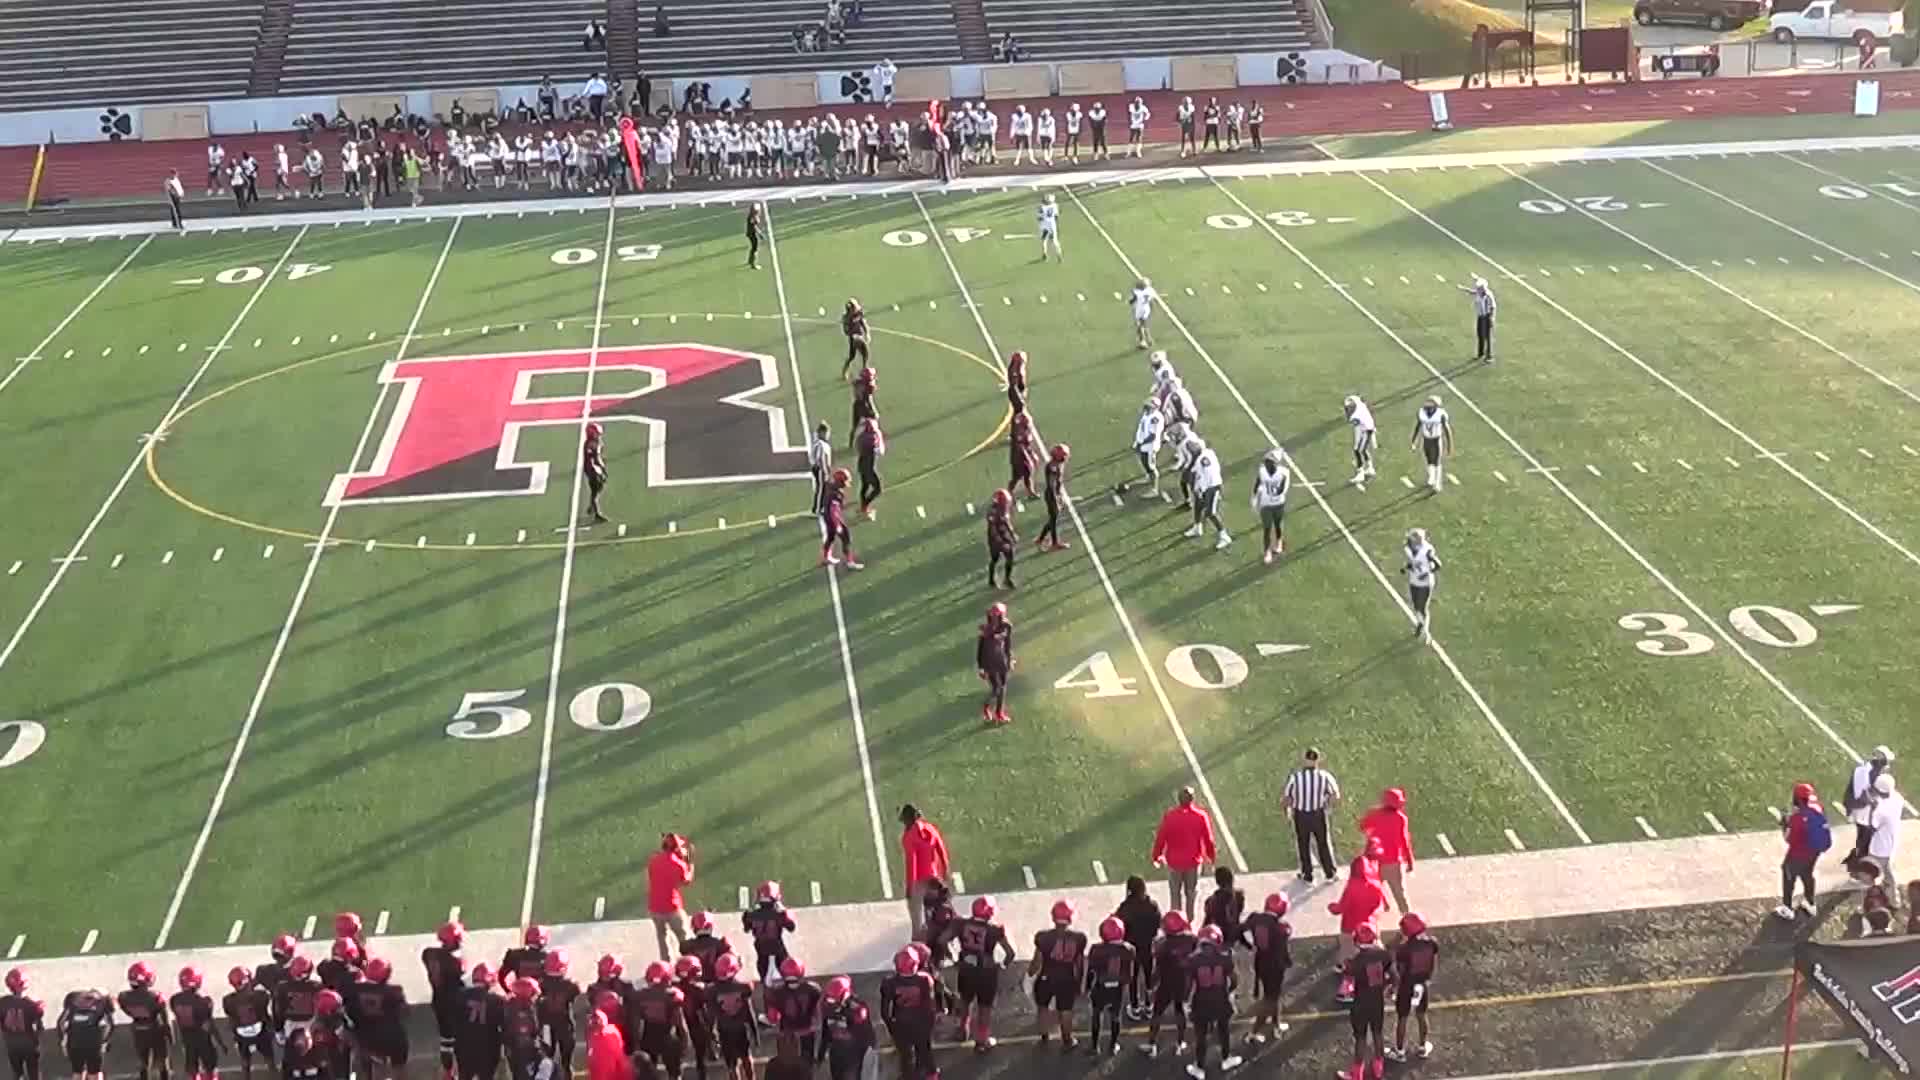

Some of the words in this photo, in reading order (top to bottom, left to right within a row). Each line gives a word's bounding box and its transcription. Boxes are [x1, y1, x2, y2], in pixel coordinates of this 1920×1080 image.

[1519, 196, 1628, 213] 20
[1206, 211, 1316, 229] 30
[882, 228, 992, 246] 40
[551, 244, 662, 264] 50
[215, 264, 332, 283] 40
[322, 343, 813, 506] R
[1618, 605, 1817, 656] 30
[1054, 644, 1248, 698] 40
[446, 683, 651, 738] 50
